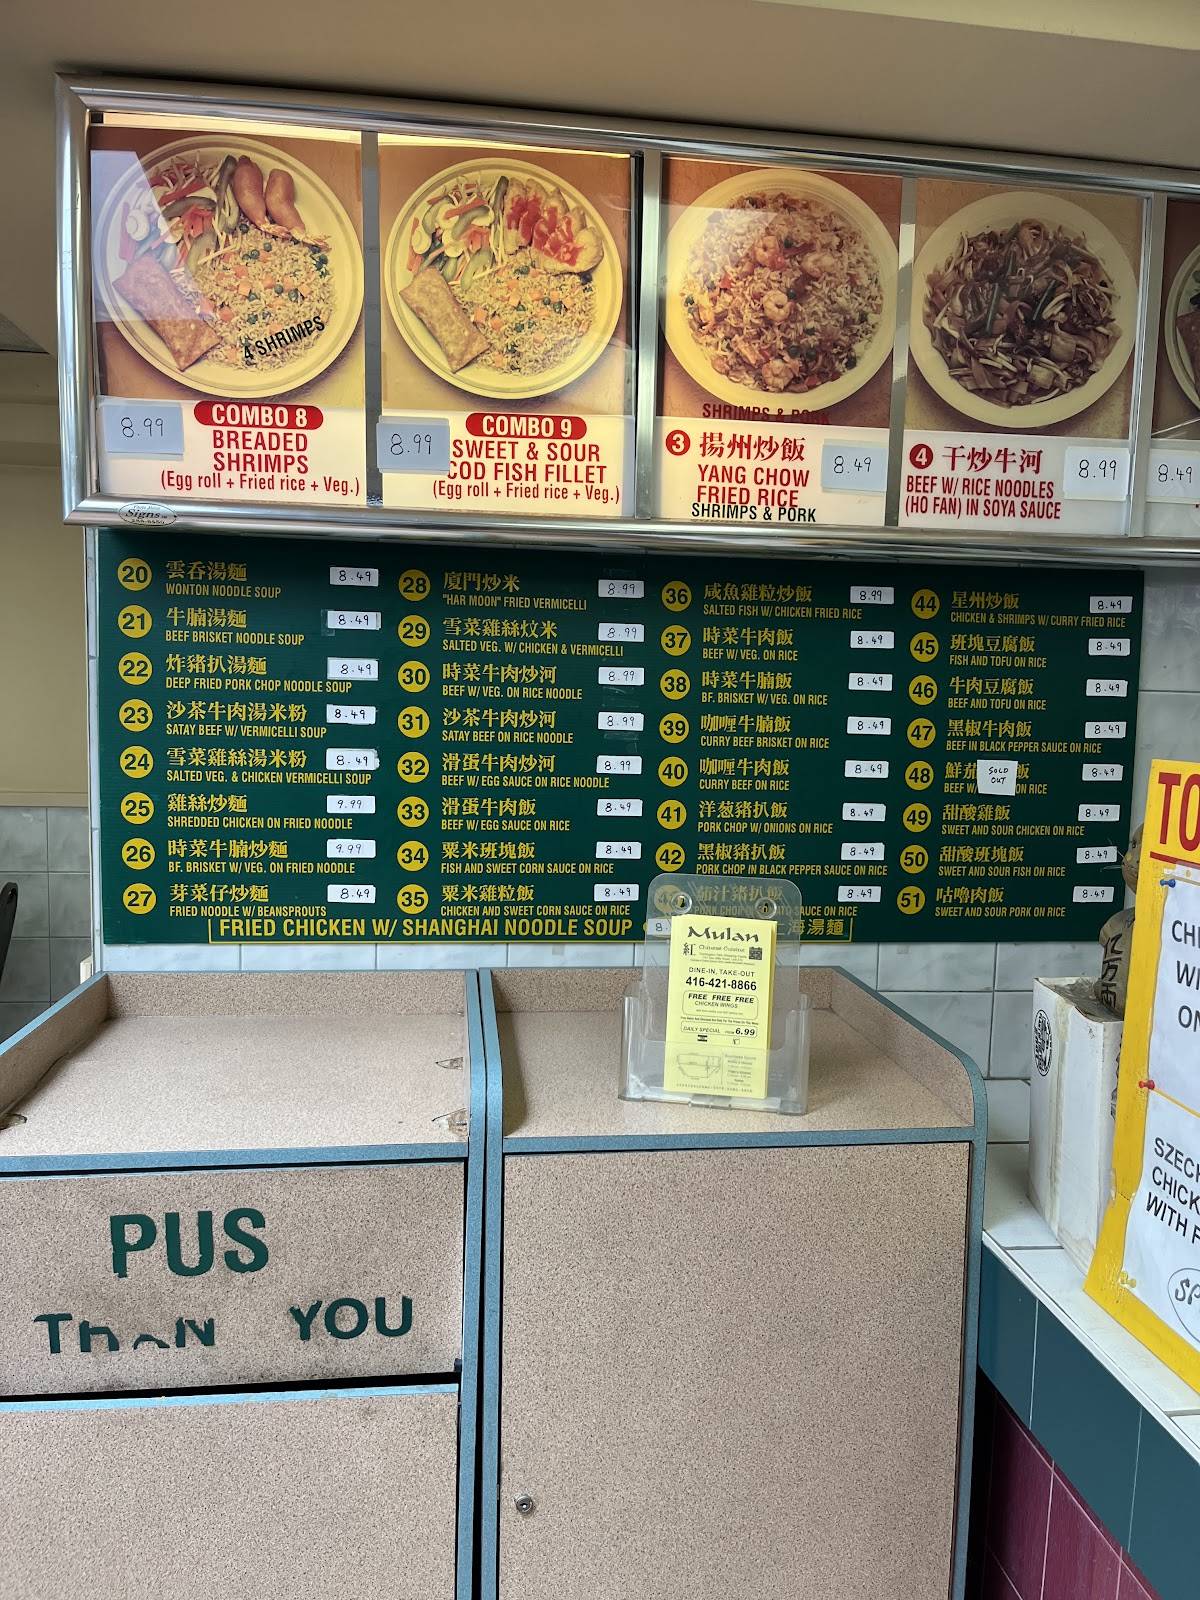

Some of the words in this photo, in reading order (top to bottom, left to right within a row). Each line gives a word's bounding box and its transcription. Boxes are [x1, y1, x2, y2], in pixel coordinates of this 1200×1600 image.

[244, 345, 254, 360] 4
[255, 315, 325, 356] SHRIMPS
[211, 403, 289, 428] COMBO
[295, 408, 308, 427] 8
[702, 403, 769, 422] SHRIMPS
[120, 416, 164, 438] 8.99
[482, 415, 554, 438] COMBO
[560, 418, 573, 438] 9
[212, 429, 308, 452] BREADED
[390, 433, 432, 456] 8.99
[669, 432, 687, 453] 3
[699, 431, 807, 462] 揚州炒飯
[452, 439, 519, 460] SWEET
[527, 441, 539, 461] &
[547, 442, 600, 462] SOUR
[914, 446, 929, 468] 4
[942, 445, 1044, 475] 干炒牛河
[213, 452, 309, 474] SHRIMPS
[447, 460, 486, 480] COD
[494, 462, 537, 482] FISH
[545, 464, 607, 484] FILLET
[833, 455, 872, 475] 8.49
[1078, 459, 1117, 481] 8.99
[697, 463, 747, 485] YANG
[753, 466, 810, 488] CHOW
[1157, 463, 1194, 484] 8.49
[160, 470, 193, 491] (Egg
[198, 472, 221, 489] roll
[239, 473, 275, 491] Fried
[280, 474, 306, 492] rice
[323, 476, 361, 497] Veg.)
[433, 479, 463, 500] (Egg
[467, 481, 490, 497] roll
[506, 482, 540, 499] Fried
[544, 483, 568, 500] rice
[585, 485, 621, 505] Veg.)
[906, 475, 938, 494] BEEF
[942, 478, 959, 496] W/
[962, 477, 991, 497] RICE
[995, 480, 1055, 499] NOODLES
[696, 485, 750, 506] FRIED
[757, 489, 799, 508] RICE
[125, 508, 161, 520] Signs
[691, 502, 757, 520] SHRIMPS
[763, 506, 773, 521] &
[778, 506, 816, 523] PORK
[905, 495, 929, 515] (HO
[933, 496, 962, 519] FAN)
[966, 499, 979, 516] IN
[983, 499, 1016, 518] SOYA
[1020, 501, 1062, 520] SAUCE
[121, 565, 149, 585] 20
[338, 569, 372, 582] 8.49
[165, 583, 210, 597] WONTON
[212, 584, 252, 598] NOODLE
[254, 586, 281, 599] SOUP
[664, 631, 689, 649] 37
[702, 626, 794, 647] 時菜牛肉飯
[856, 634, 884, 645] 8.49
[950, 634, 1037, 653] 班塊豆腐飯
[702, 648, 724, 660] BEEF
[725, 648, 739, 661] W/
[739, 649, 761, 661] VEG.
[762, 649, 776, 661] ON
[778, 650, 798, 661] RICE
[913, 638, 936, 656] 45
[1096, 641, 1122, 652] 8.49
[949, 655, 969, 666] FISH
[970, 655, 988, 667] AND
[989, 656, 1013, 667] TOFU
[1014, 656, 1026, 668] ON
[1027, 657, 1047, 668] RICE
[661, 763, 685, 780] 40
[854, 763, 883, 774] 8.49
[907, 767, 932, 784] 48
[988, 766, 1009, 775] SOLD
[1091, 767, 1115, 778] 8.49
[699, 779, 730, 790] CURRY
[731, 779, 753, 790] BEEF
[755, 779, 767, 790] ON
[769, 780, 790, 791] RICE
[990, 775, 1007, 784] OUT
[401, 803, 425, 820] 33
[441, 797, 537, 817] 滑蛋牛肉飯
[604, 802, 632, 813] 8.49
[441, 819, 464, 830] BEEF
[466, 819, 480, 831] W/
[480, 819, 500, 831] EGG
[501, 820, 532, 831] SAUCE
[534, 820, 547, 831] ON
[549, 820, 571, 831] RICE
[126, 890, 153, 907] 27
[339, 887, 371, 899] 8.49
[899, 891, 922, 908] 51
[1082, 889, 1105, 899] 8.49
[169, 905, 198, 917] FRIED
[200, 905, 239, 917] NOODLE
[242, 905, 256, 918] W/
[257, 905, 327, 918] BEANSPROUTS
[935, 906, 963, 917] SWEET
[964, 906, 982, 917] AND
[984, 906, 1007, 917] SOUR
[1009, 906, 1031, 917] PORK
[1033, 906, 1045, 917] ON
[1046, 906, 1066, 917] RICE
[219, 919, 276, 937] FRIED
[282, 919, 365, 937] CHICKEN
[371, 919, 397, 937] W/
[402, 918, 499, 937] SHANGHAI
[504, 918, 578, 936] NOODLE
[583, 918, 633, 936] SOUP
[687, 926, 759, 943] Mulan
[719, 968, 756, 978] TAKE-OUT
[686, 976, 757, 991] 416-421-8866
[712, 994, 731, 1002] FREE
[735, 996, 755, 1004] FREE
[720, 1001, 738, 1009] WINGS
[735, 1027, 756, 1036] 6.99
[1146, 1191, 1188, 1238] WITH
[109, 1207, 270, 1278] PUS
[288, 1295, 413, 1341] YOU
